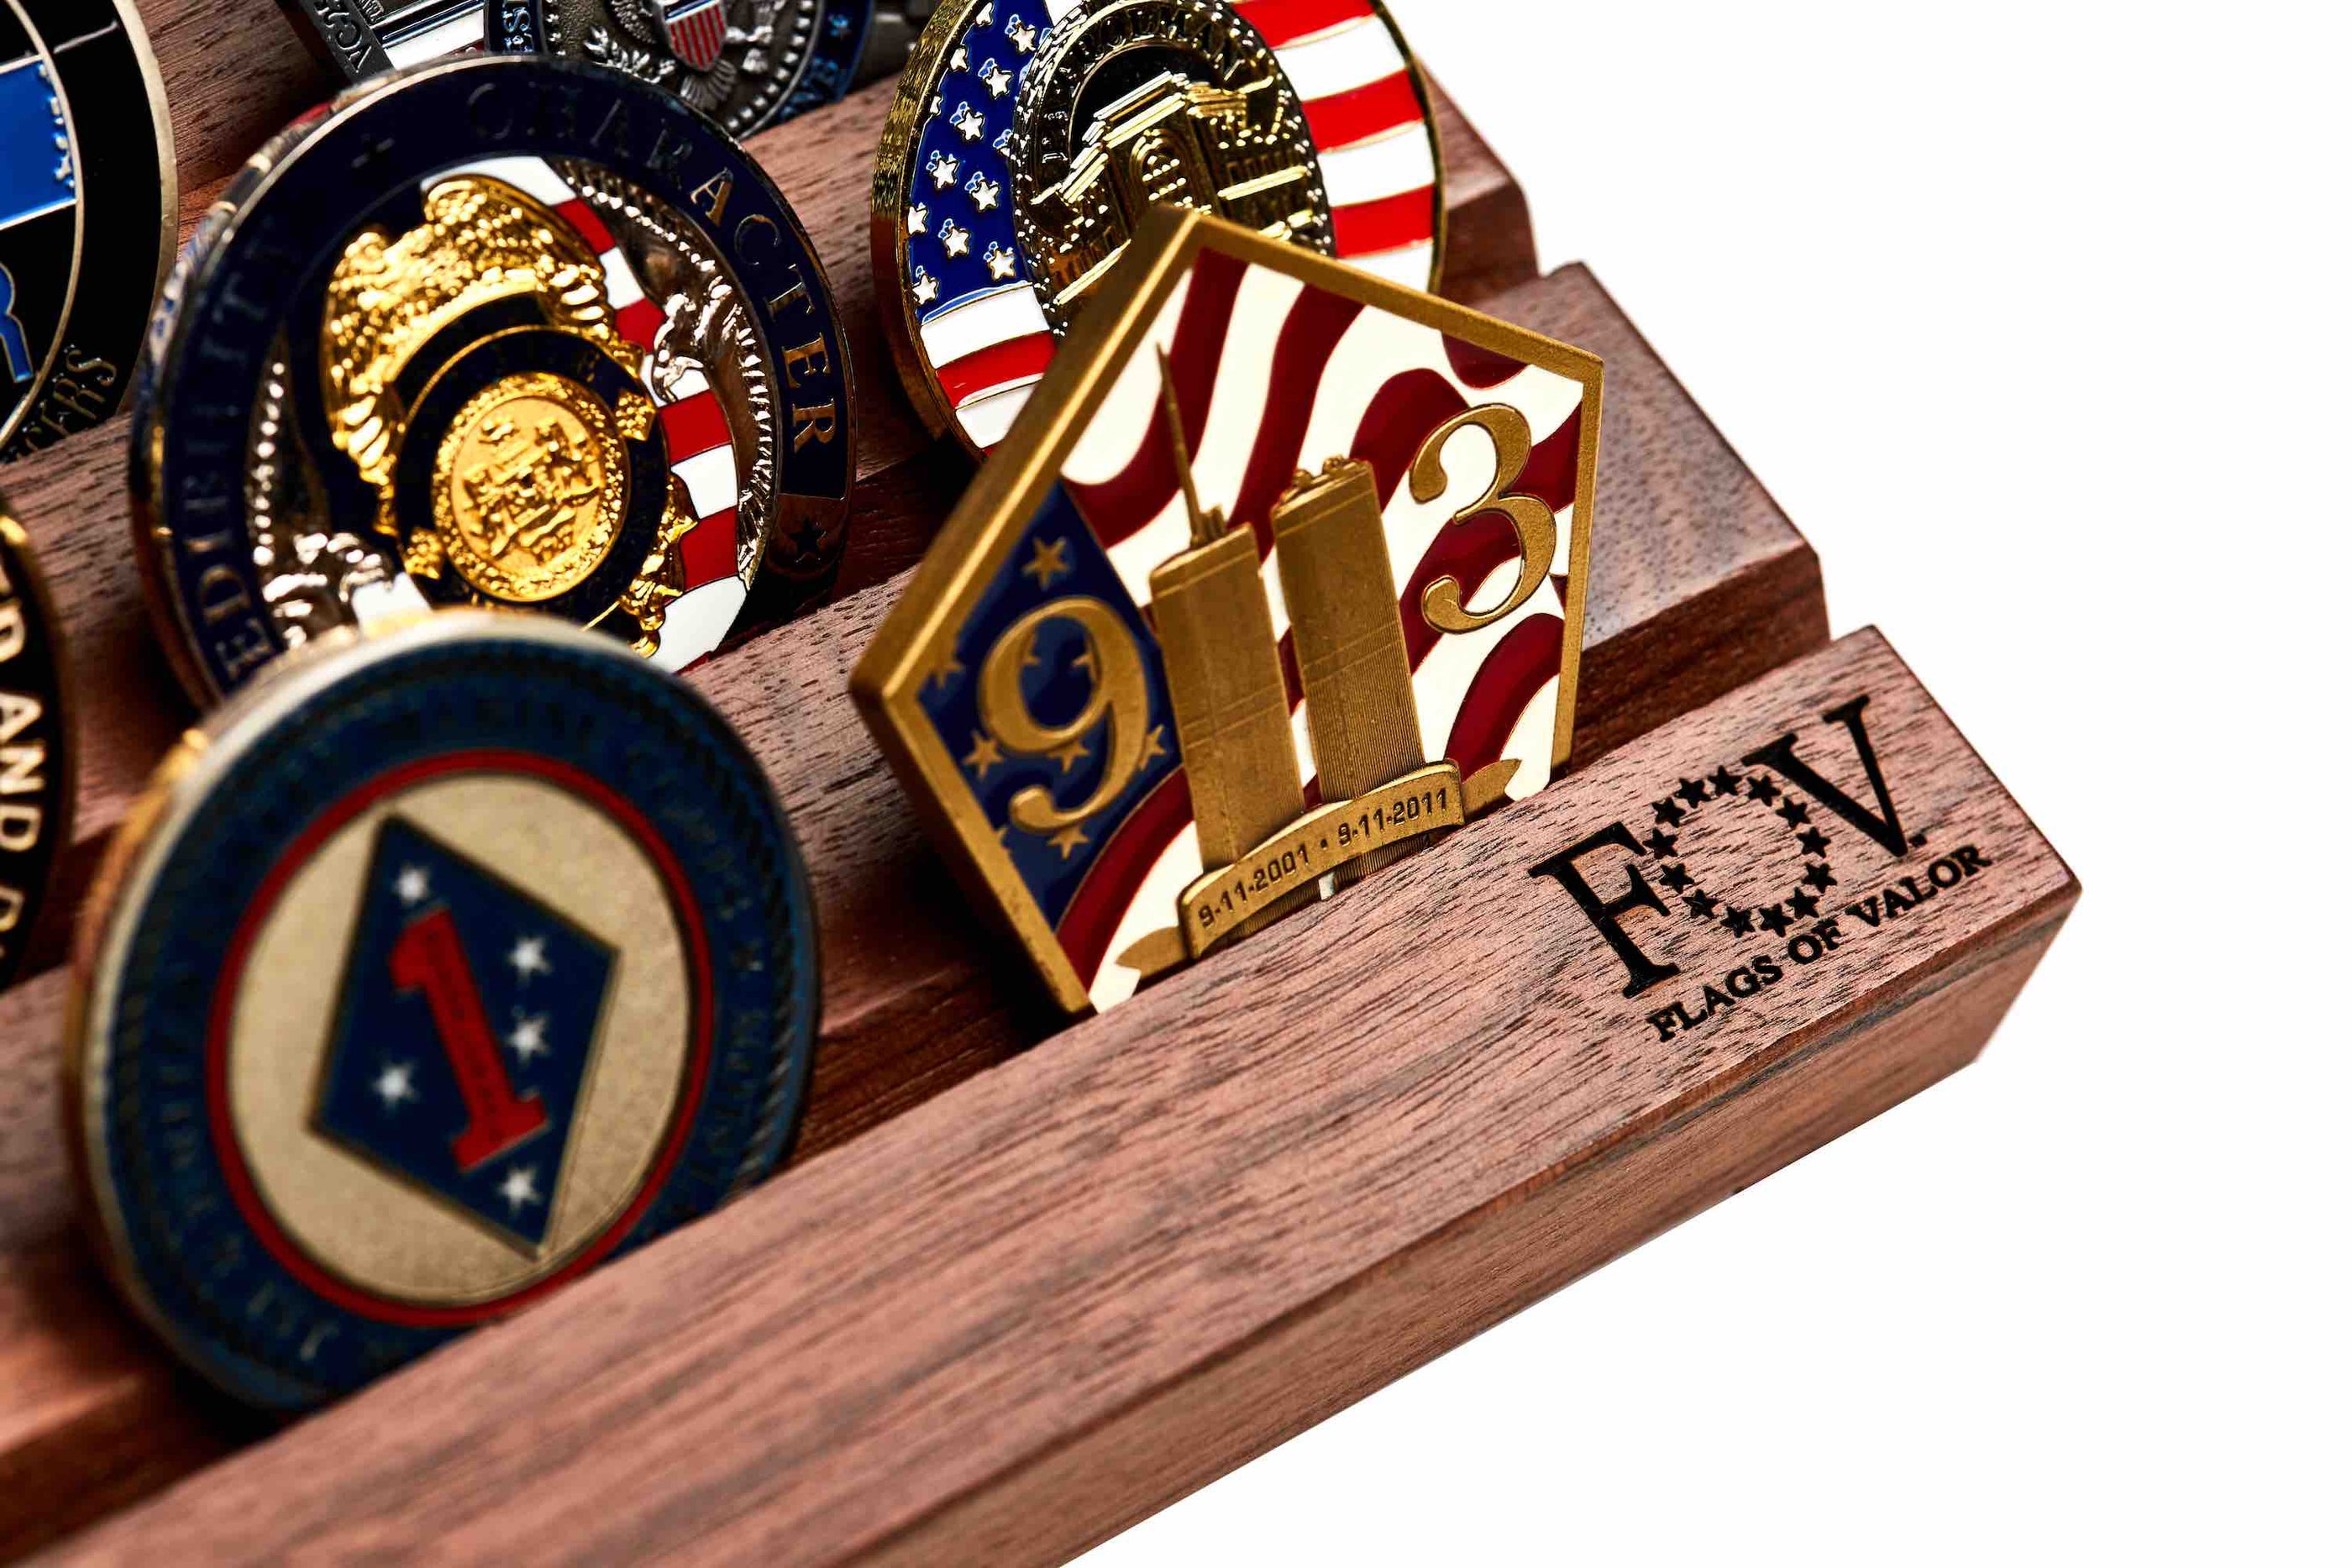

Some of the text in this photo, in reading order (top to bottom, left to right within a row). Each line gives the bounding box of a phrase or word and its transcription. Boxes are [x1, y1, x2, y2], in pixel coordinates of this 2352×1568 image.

[1197, 787, 1448, 929] 9-11-2001 9-11-2011
[1646, 843, 1994, 1043] FLAGS OF VALOR
[387, 904, 551, 1173] 1
